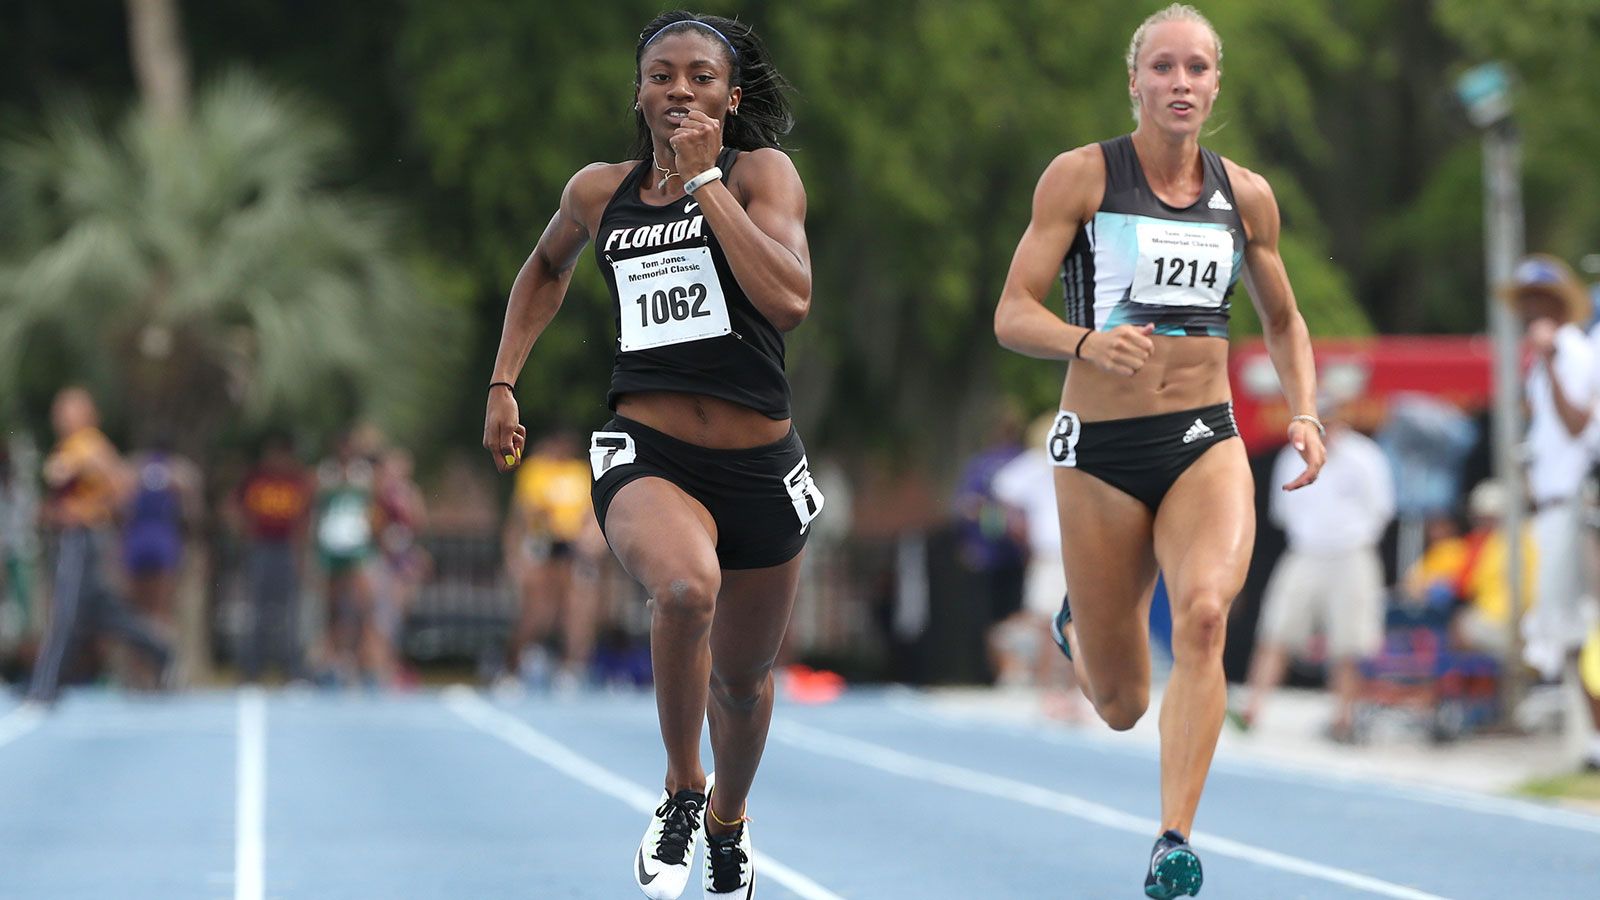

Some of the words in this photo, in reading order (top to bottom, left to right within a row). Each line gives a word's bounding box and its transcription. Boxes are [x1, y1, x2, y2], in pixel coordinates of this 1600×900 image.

[603, 215, 704, 252] FLORIDA
[628, 267, 668, 282] Memorial
[670, 263, 701, 273] Classic
[641, 261, 659, 269] Tom
[660, 256, 686, 265] Jones
[1154, 257, 1218, 288] 1214
[636, 283, 711, 327] 1062
[596, 437, 627, 471] 7
[1050, 415, 1074, 462] 8
